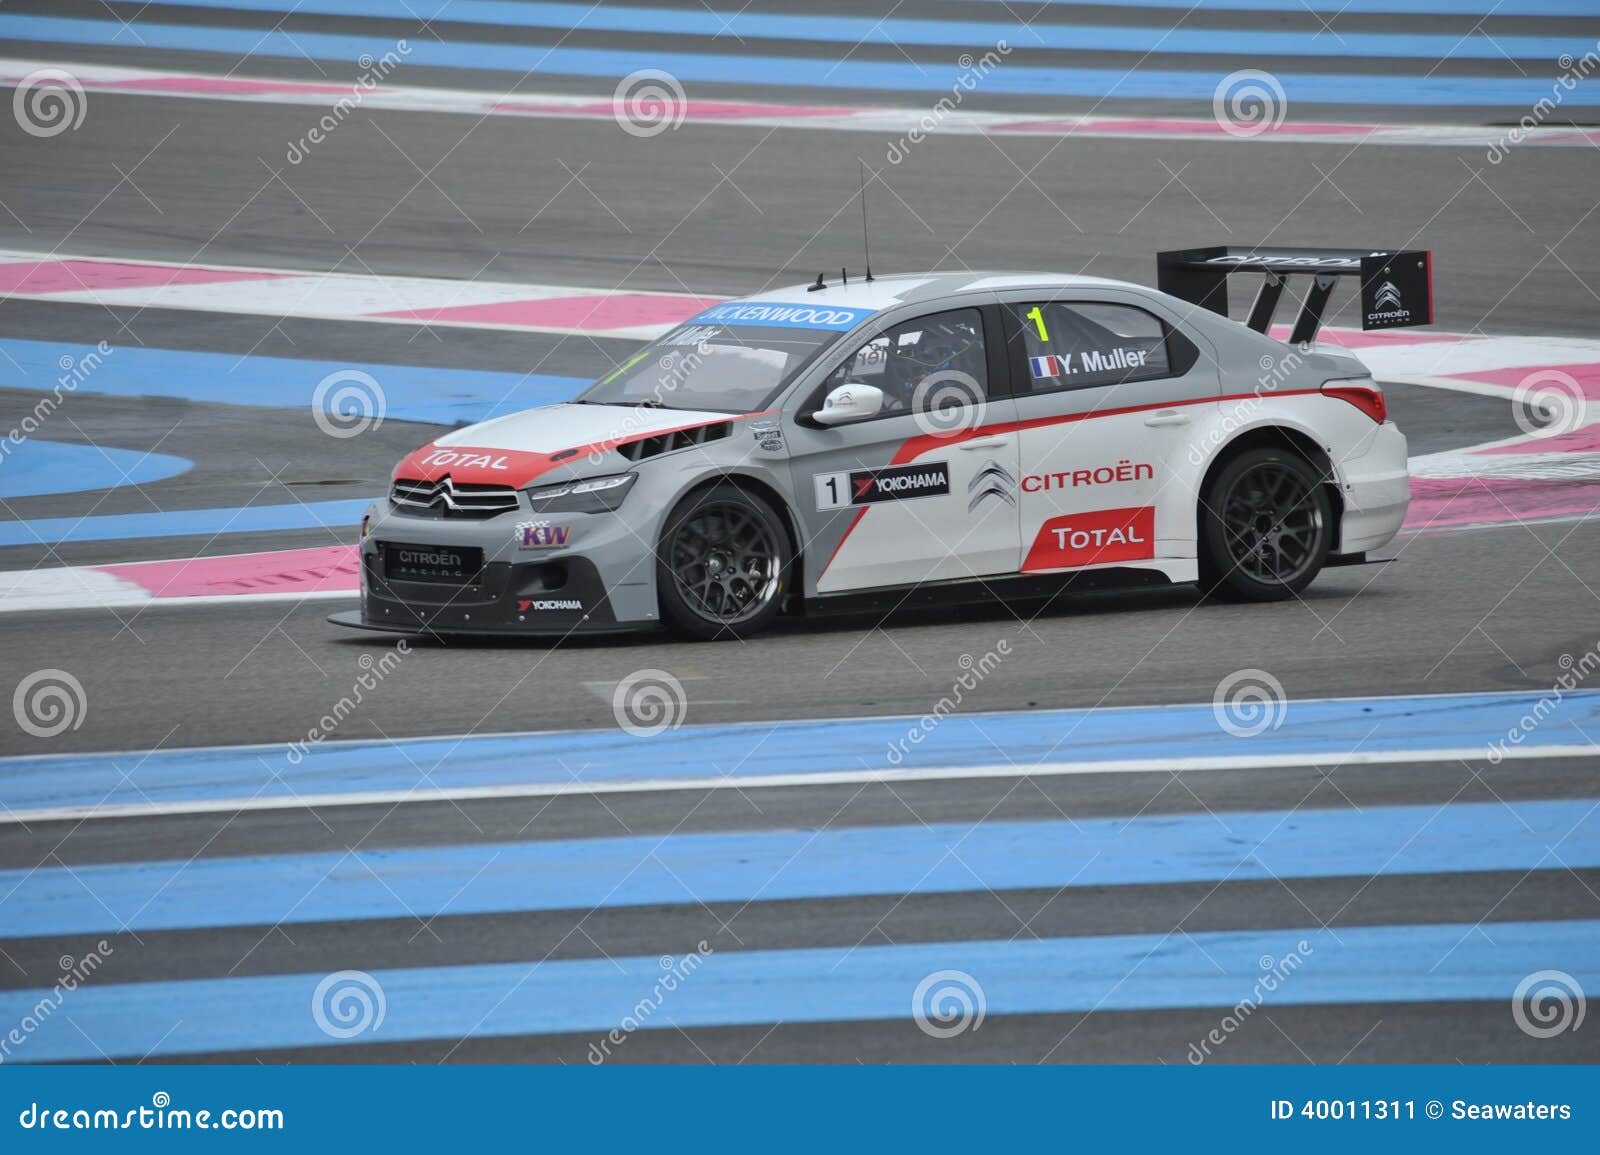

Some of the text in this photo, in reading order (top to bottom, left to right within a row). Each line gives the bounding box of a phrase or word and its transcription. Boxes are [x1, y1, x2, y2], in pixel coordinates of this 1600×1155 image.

[1027, 307, 1048, 341] 1
[1056, 347, 1148, 375] Y. Muller
[422, 449, 509, 470] TOTAL
[825, 477, 838, 504] 1
[874, 471, 947, 493] YOKOHAMA
[522, 526, 571, 548] KW
[532, 600, 583, 610] YOKOHAMA
